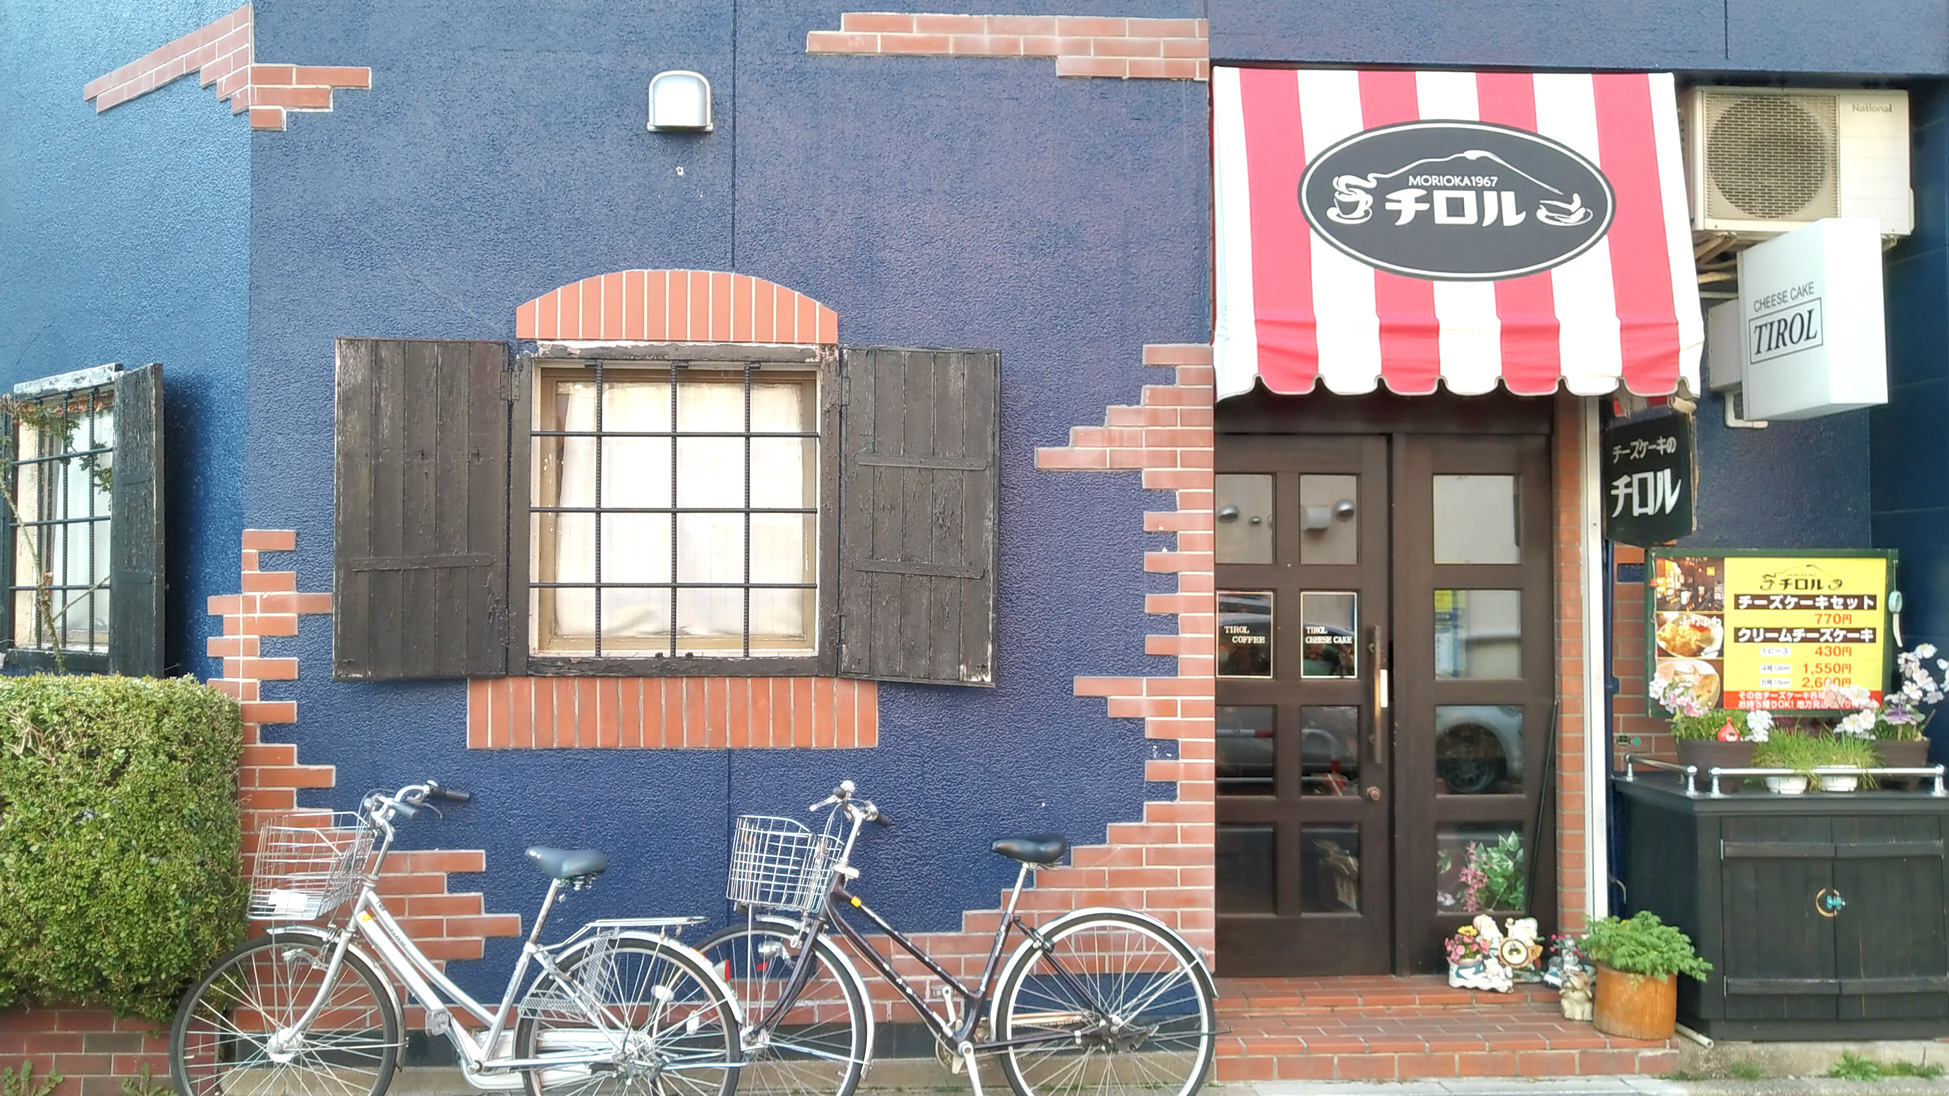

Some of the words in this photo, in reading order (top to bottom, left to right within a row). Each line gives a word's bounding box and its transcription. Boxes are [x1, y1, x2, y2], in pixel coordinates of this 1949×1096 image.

[1852, 103, 1892, 113] National
[1408, 175, 1498, 187] MORIOKA1967
[1384, 188, 1526, 227] チロル
[1753, 290, 1788, 312] CHEESE
[1790, 281, 1815, 301] CAKE
[1753, 308, 1818, 355] TIROL
[1610, 468, 1682, 518] チロル
[1779, 578, 1825, 591] チロル
[1738, 595, 1875, 610] チーズケーキセット
[1814, 613, 1852, 625] 770円
[1224, 626, 1250, 634] TIROL
[1306, 626, 1328, 634] TIROL
[1738, 628, 1874, 642] クリームチーズケーキ
[1232, 636, 1266, 644] COFFEE
[1305, 636, 1332, 644] CHEESE
[1333, 636, 1353, 644] CAKE
[1814, 646, 1852, 657] 430円
[1803, 662, 1852, 675] 1,550円
